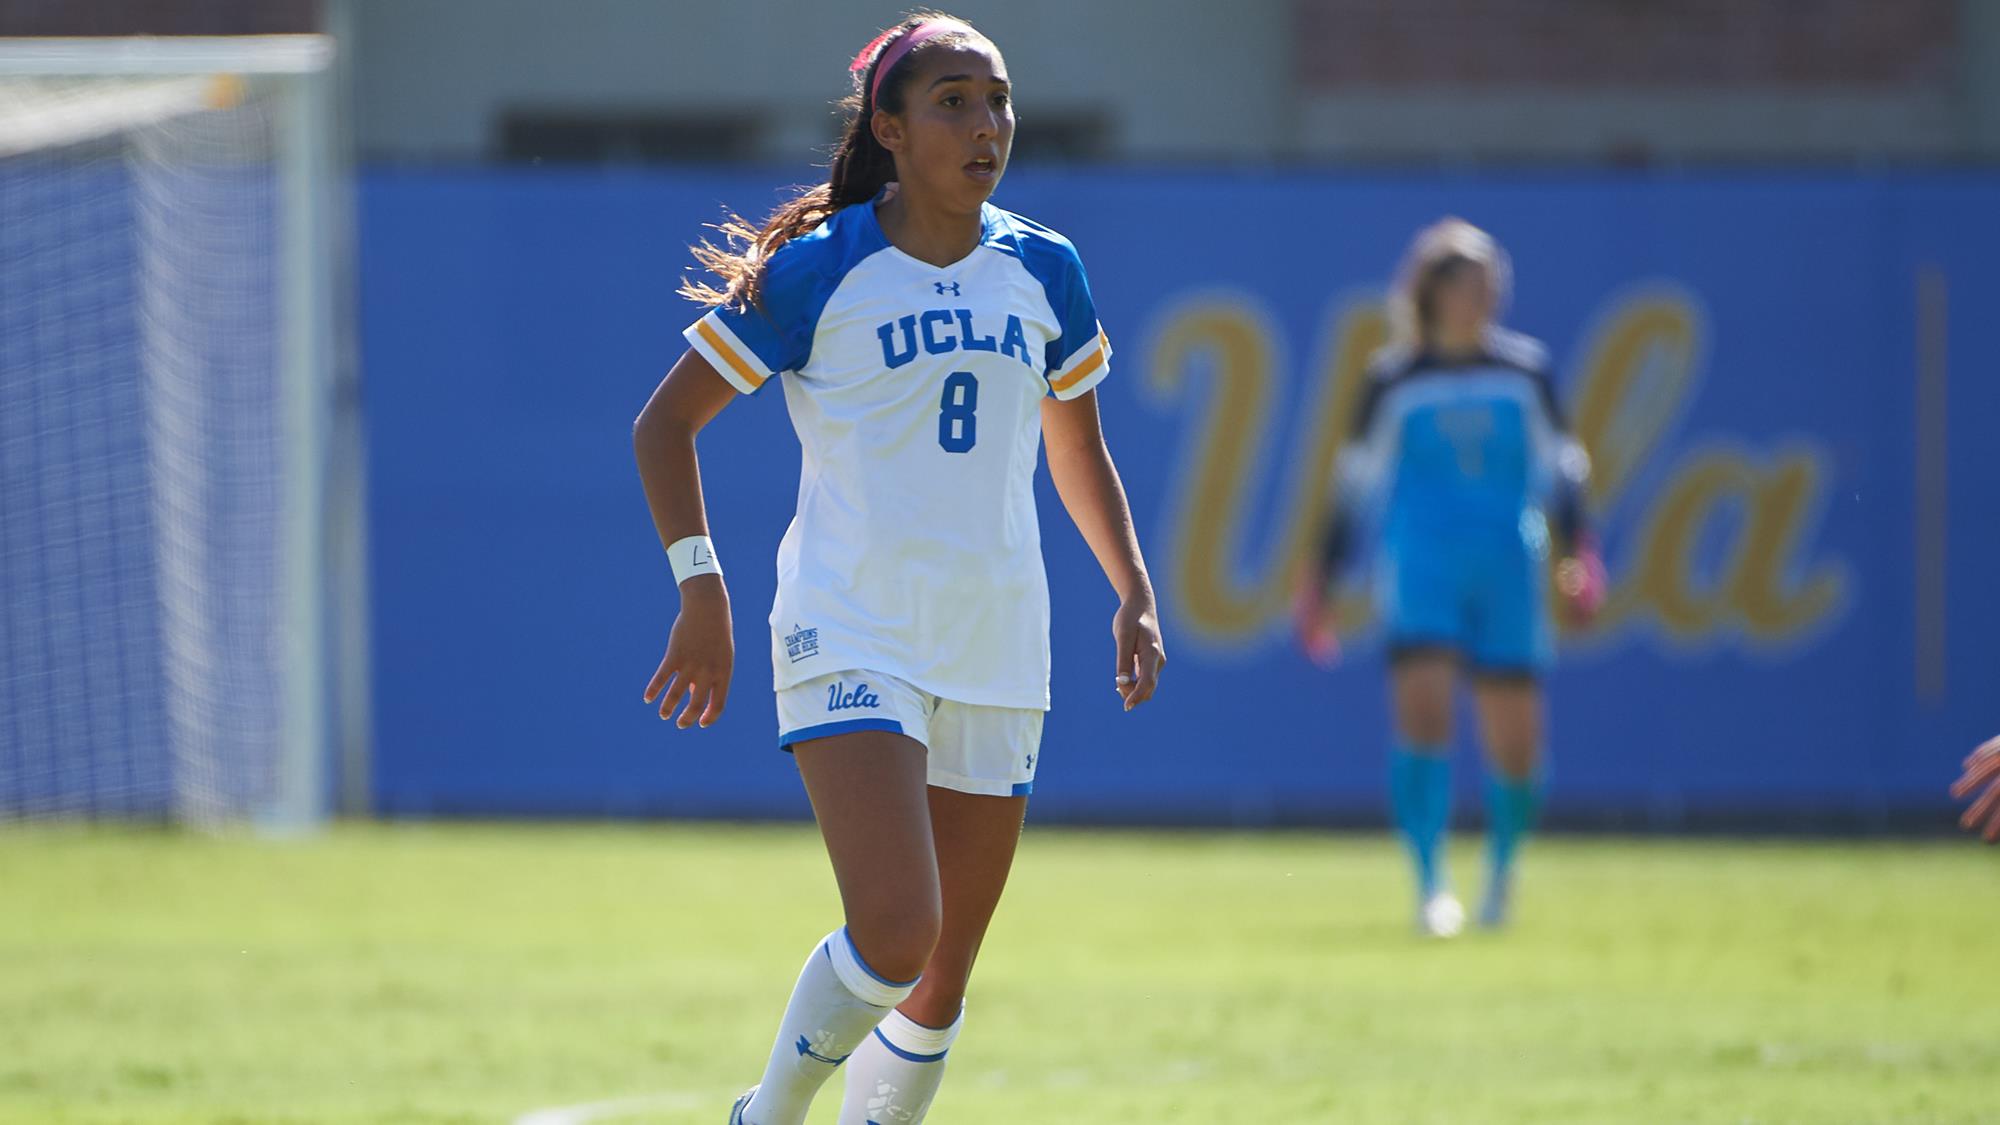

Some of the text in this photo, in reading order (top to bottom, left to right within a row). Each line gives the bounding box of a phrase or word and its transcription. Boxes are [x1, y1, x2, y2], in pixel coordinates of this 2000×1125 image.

[877, 309, 1032, 369] UCLA
[939, 372, 978, 453] 8
[1147, 296, 1845, 642] Ula
[828, 681, 880, 711] Ucla
